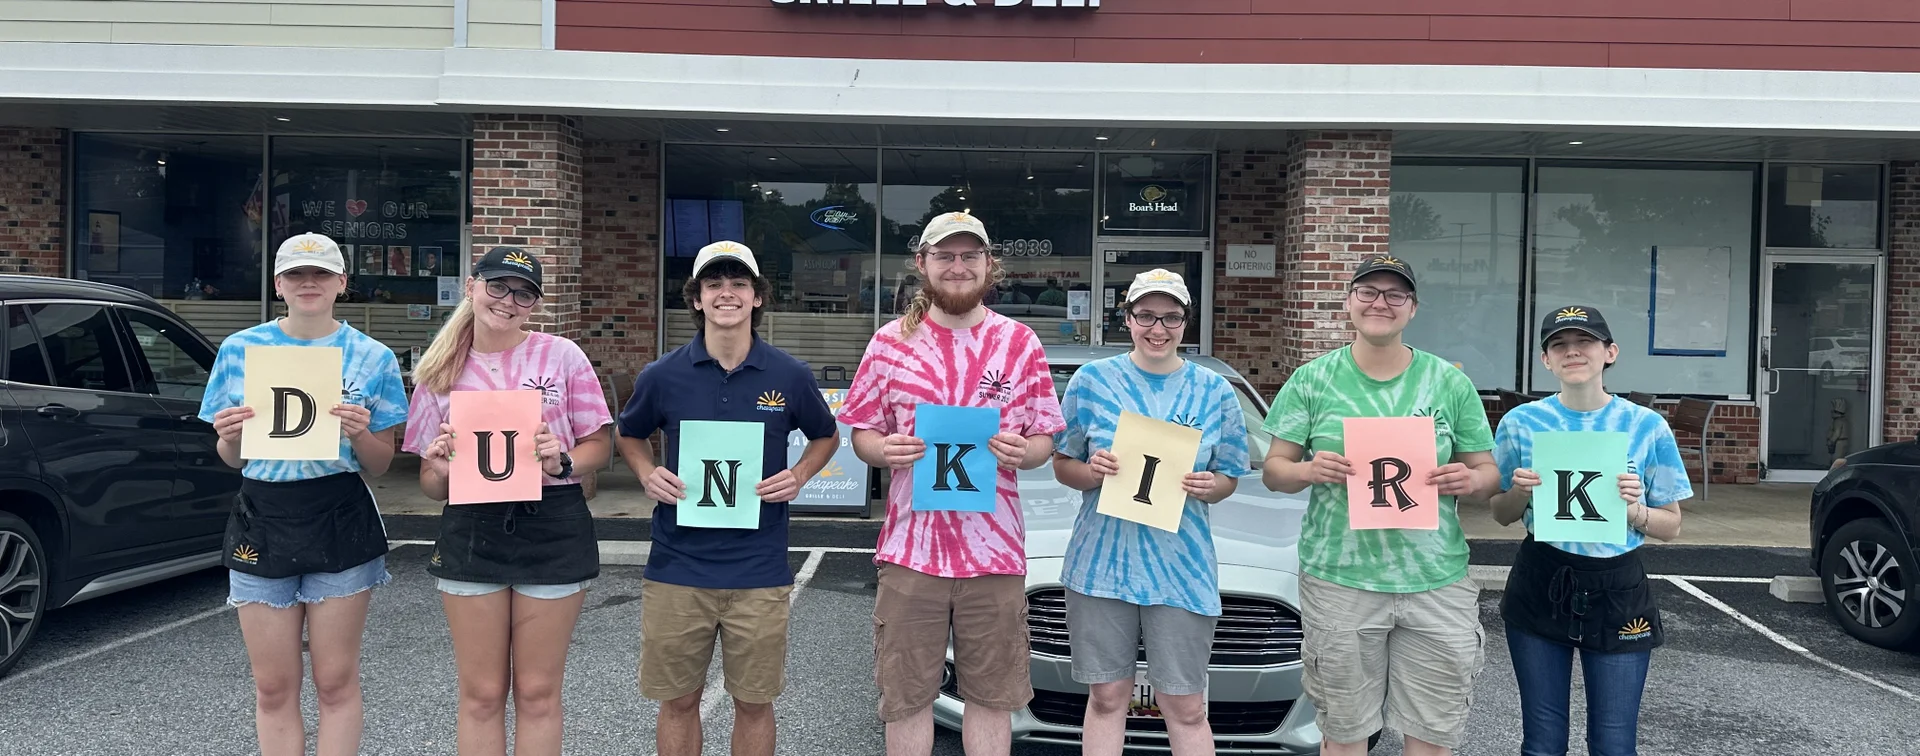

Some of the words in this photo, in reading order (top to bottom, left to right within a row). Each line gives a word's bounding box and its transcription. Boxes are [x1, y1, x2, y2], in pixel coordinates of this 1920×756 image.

[301, 200, 336, 217] WE
[382, 200, 429, 219] OUR
[321, 220, 407, 240] SENIORS
[1129, 202, 1154, 212] Boar's
[1155, 202, 1178, 212] Head
[1228, 261, 1273, 271] LOITERING
[1244, 250, 1257, 258] NO
[269, 388, 316, 438] D
[473, 431, 518, 481] U
[932, 443, 980, 492] K
[1133, 454, 1161, 506] I
[697, 460, 742, 507] N
[1367, 457, 1419, 512] R
[1554, 470, 1608, 522] K
